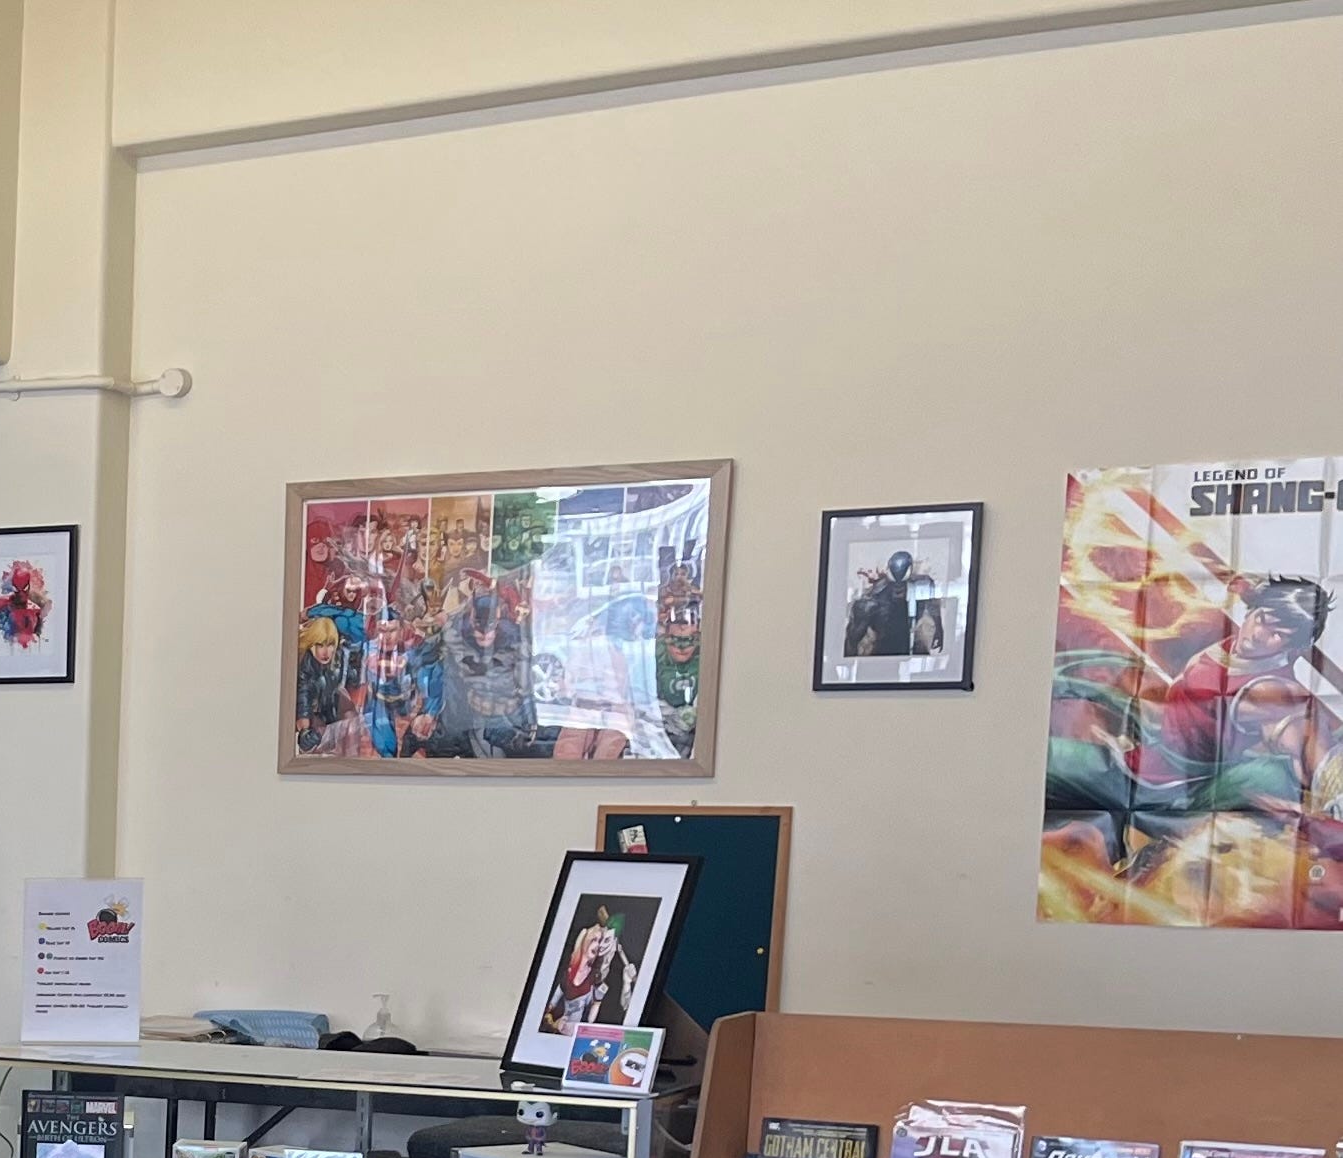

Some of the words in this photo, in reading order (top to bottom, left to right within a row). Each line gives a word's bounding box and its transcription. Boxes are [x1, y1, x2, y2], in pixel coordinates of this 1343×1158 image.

[1194, 468, 1258, 482] LEGEND
[1265, 468, 1286, 479] OF
[1190, 479, 1343, 517] SHANG-
[86, 1101, 118, 1115] MARVEL
[27, 1119, 117, 1136] AVENGERS
